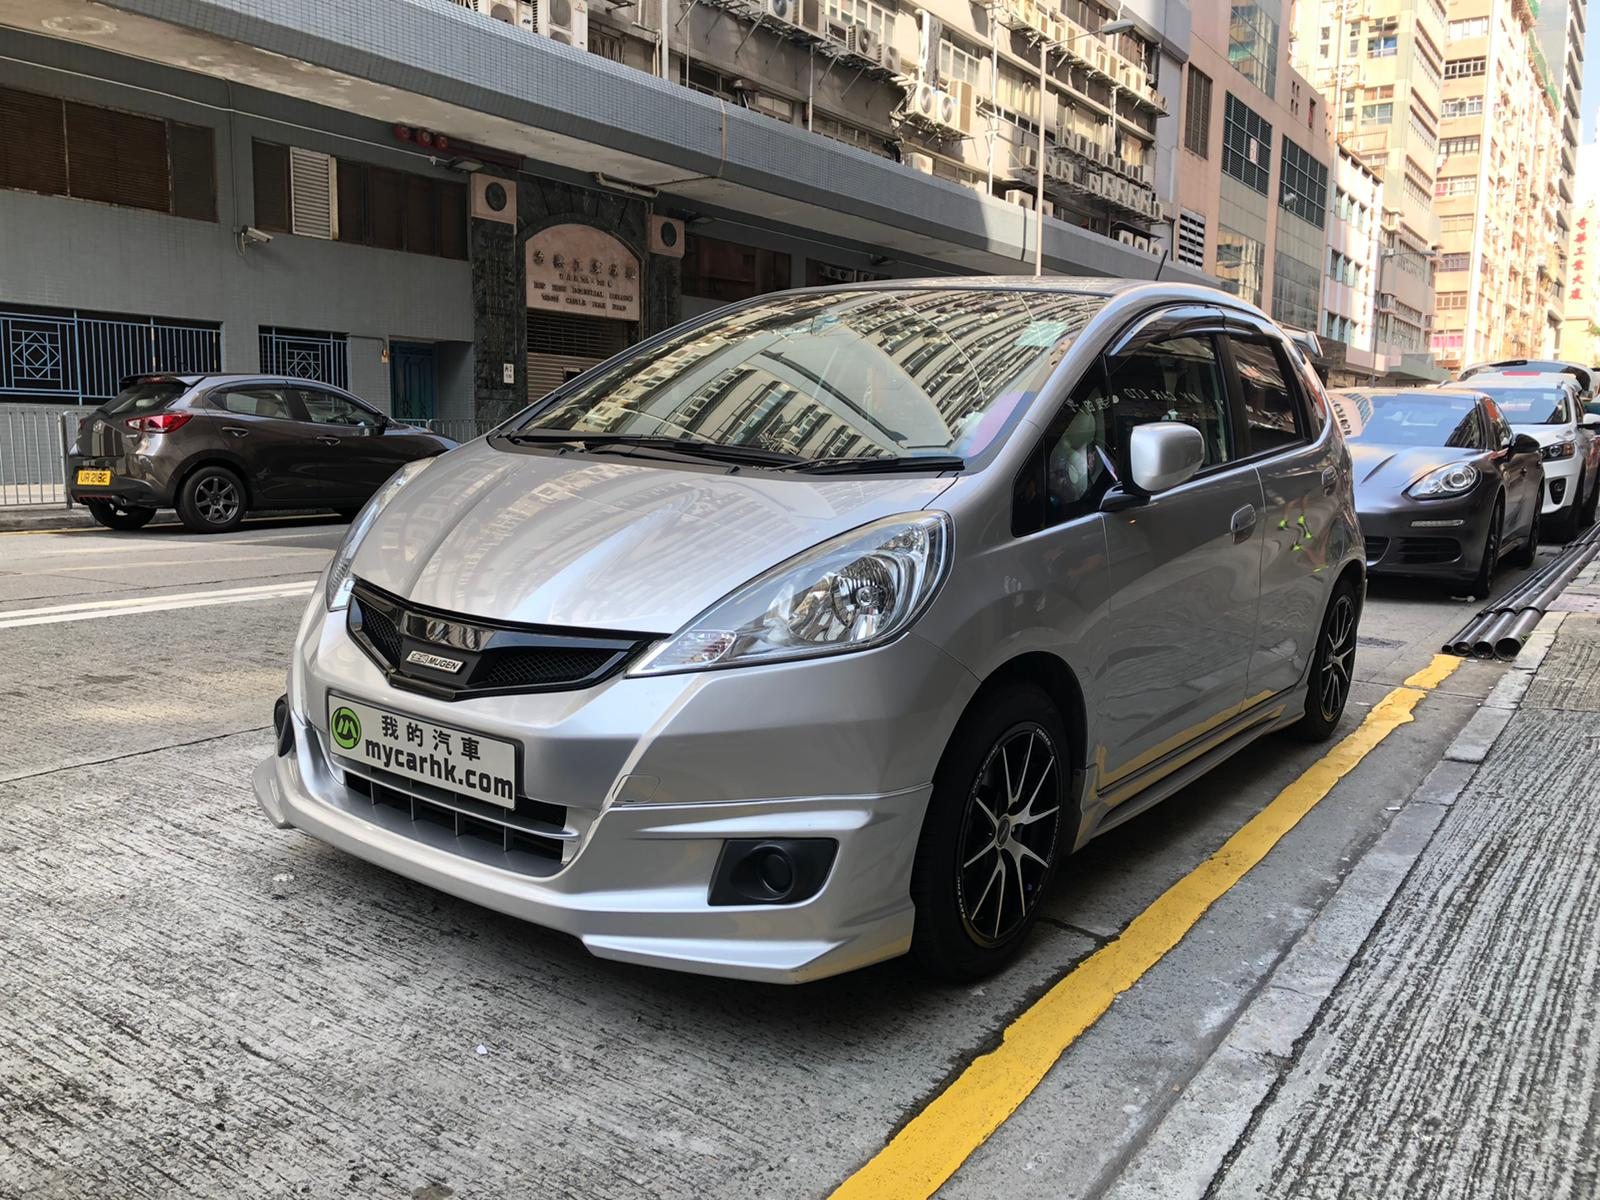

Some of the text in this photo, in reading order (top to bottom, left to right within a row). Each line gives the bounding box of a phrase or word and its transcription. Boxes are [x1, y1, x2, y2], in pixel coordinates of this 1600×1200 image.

[428, 656, 459, 669] MUGEN
[381, 715, 481, 761] 我的汽車
[365, 739, 513, 799] mycarhk.com
